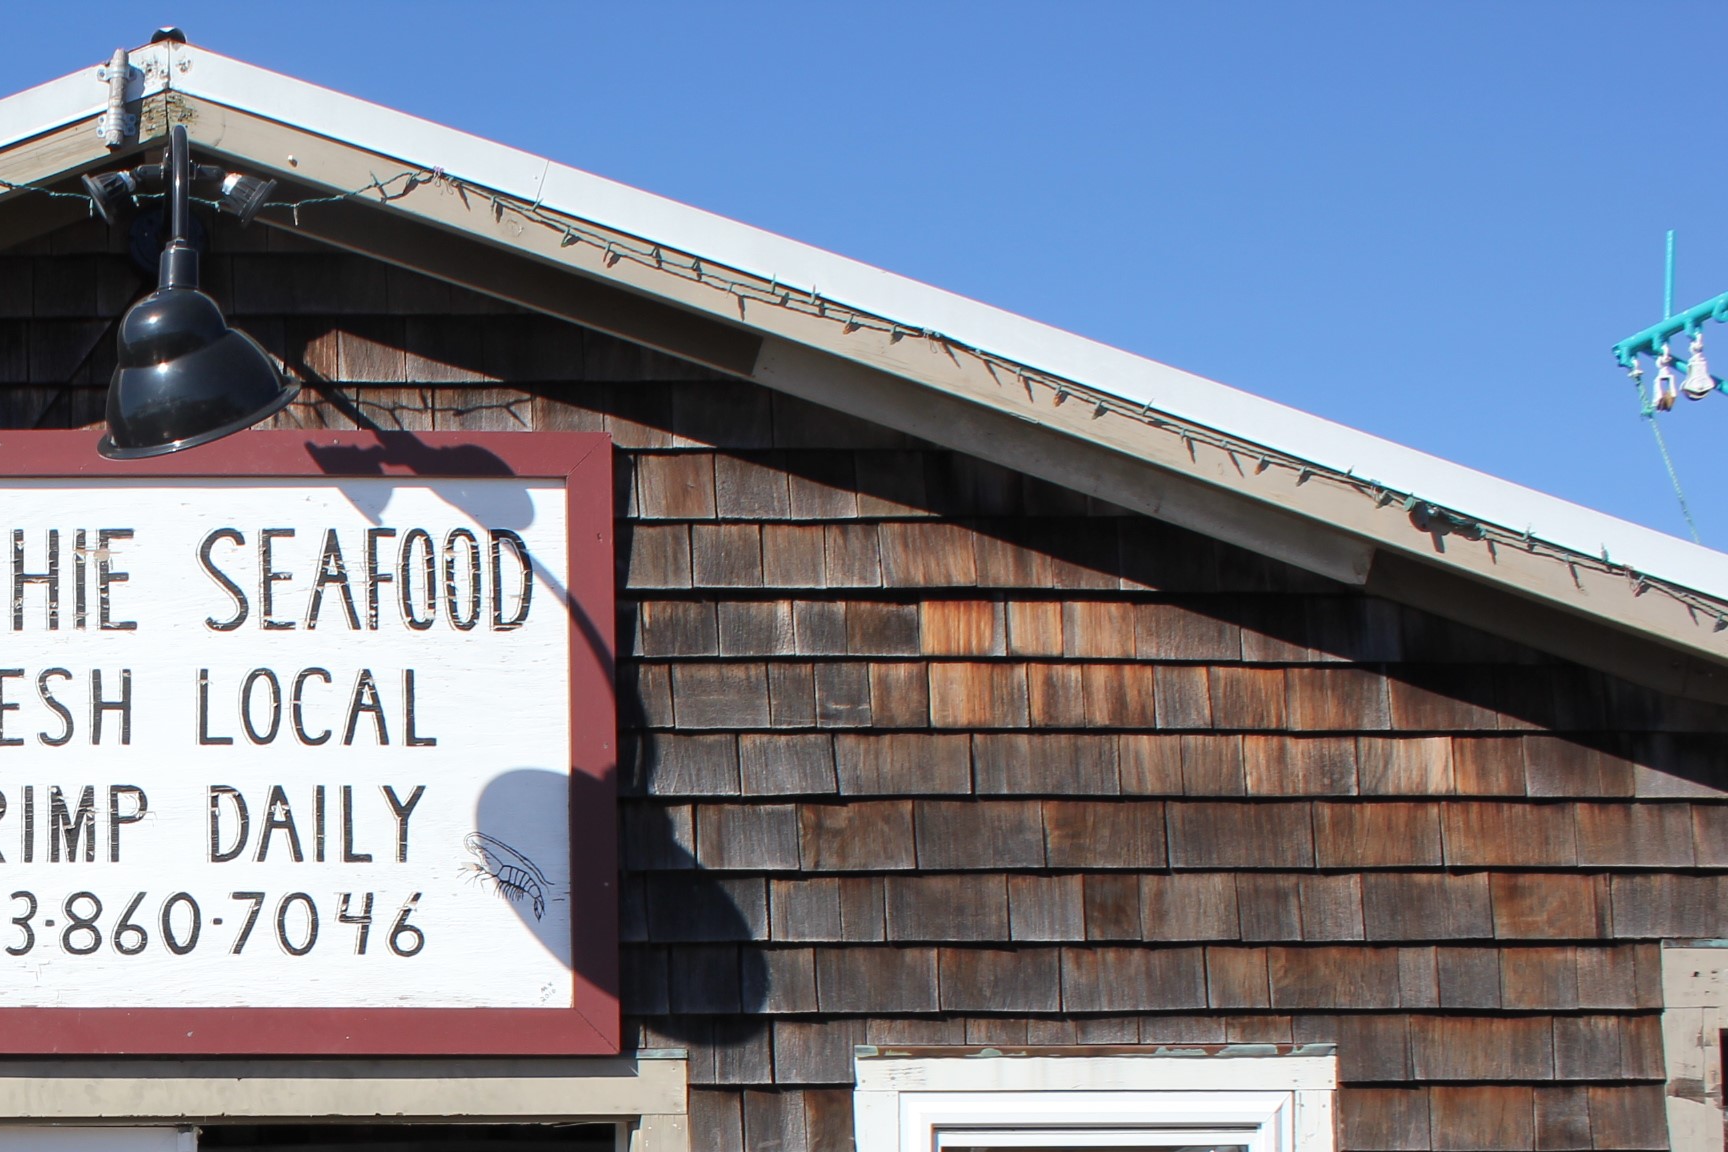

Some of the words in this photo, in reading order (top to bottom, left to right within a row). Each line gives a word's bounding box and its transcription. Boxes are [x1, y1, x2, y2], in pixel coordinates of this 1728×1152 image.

[196, 527, 534, 633] SEAFOOD
[197, 667, 438, 748] LOCAL
[208, 784, 427, 864] DAILY
